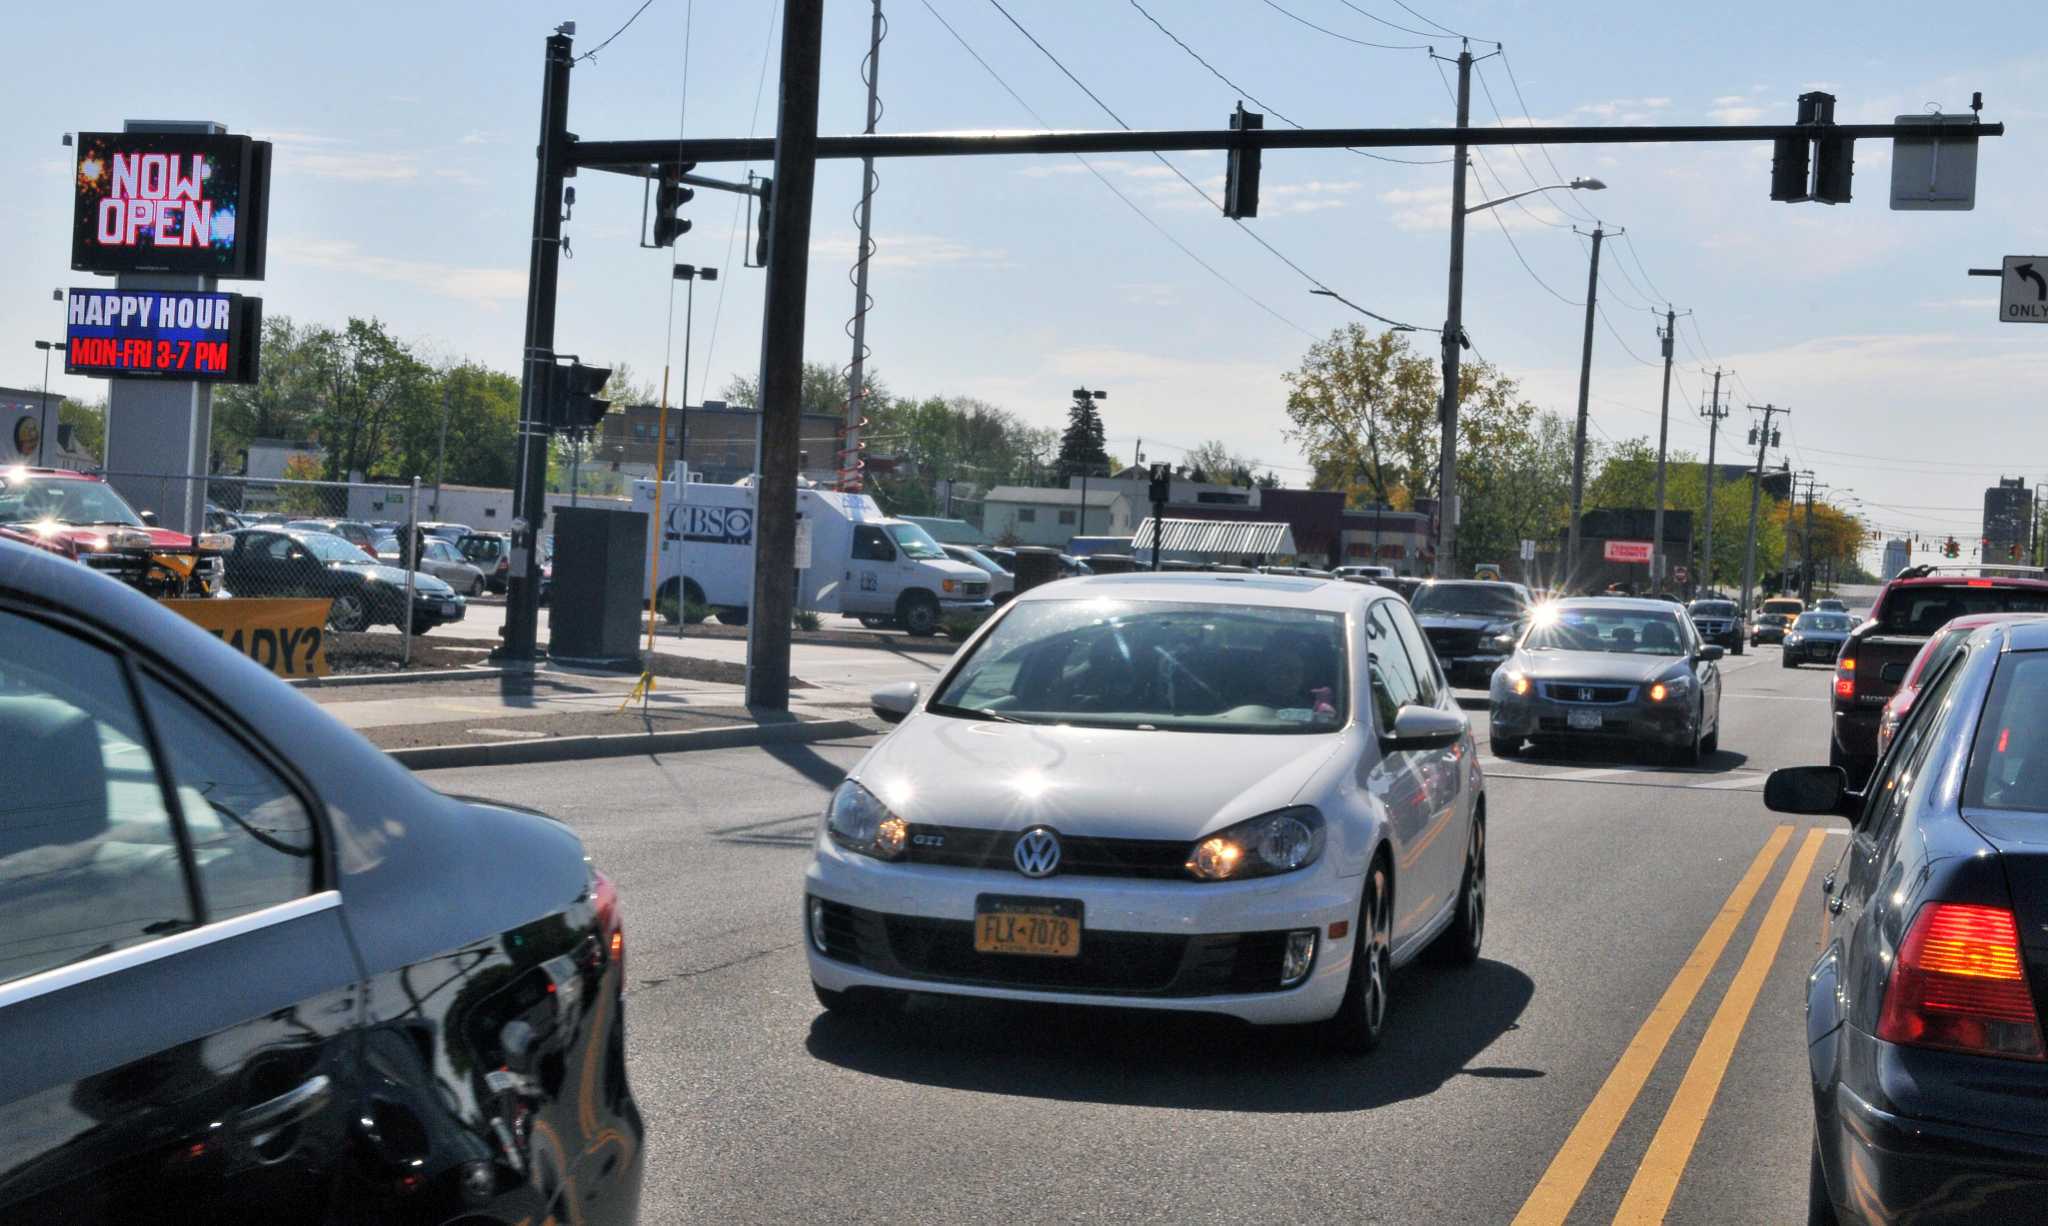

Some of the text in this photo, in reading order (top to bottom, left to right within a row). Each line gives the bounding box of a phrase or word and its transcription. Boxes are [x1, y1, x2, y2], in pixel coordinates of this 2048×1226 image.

[111, 152, 205, 201] NOW
[97, 198, 212, 246] OPEN
[69, 294, 230, 330] HAPPY HOUR
[2009, 304, 2048, 317] ONLY
[71, 337, 229, 371] MON-FRI 3-7 PM
[669, 506, 724, 534] CBS
[209, 626, 321, 674] ADY?
[912, 834, 945, 847] GTI
